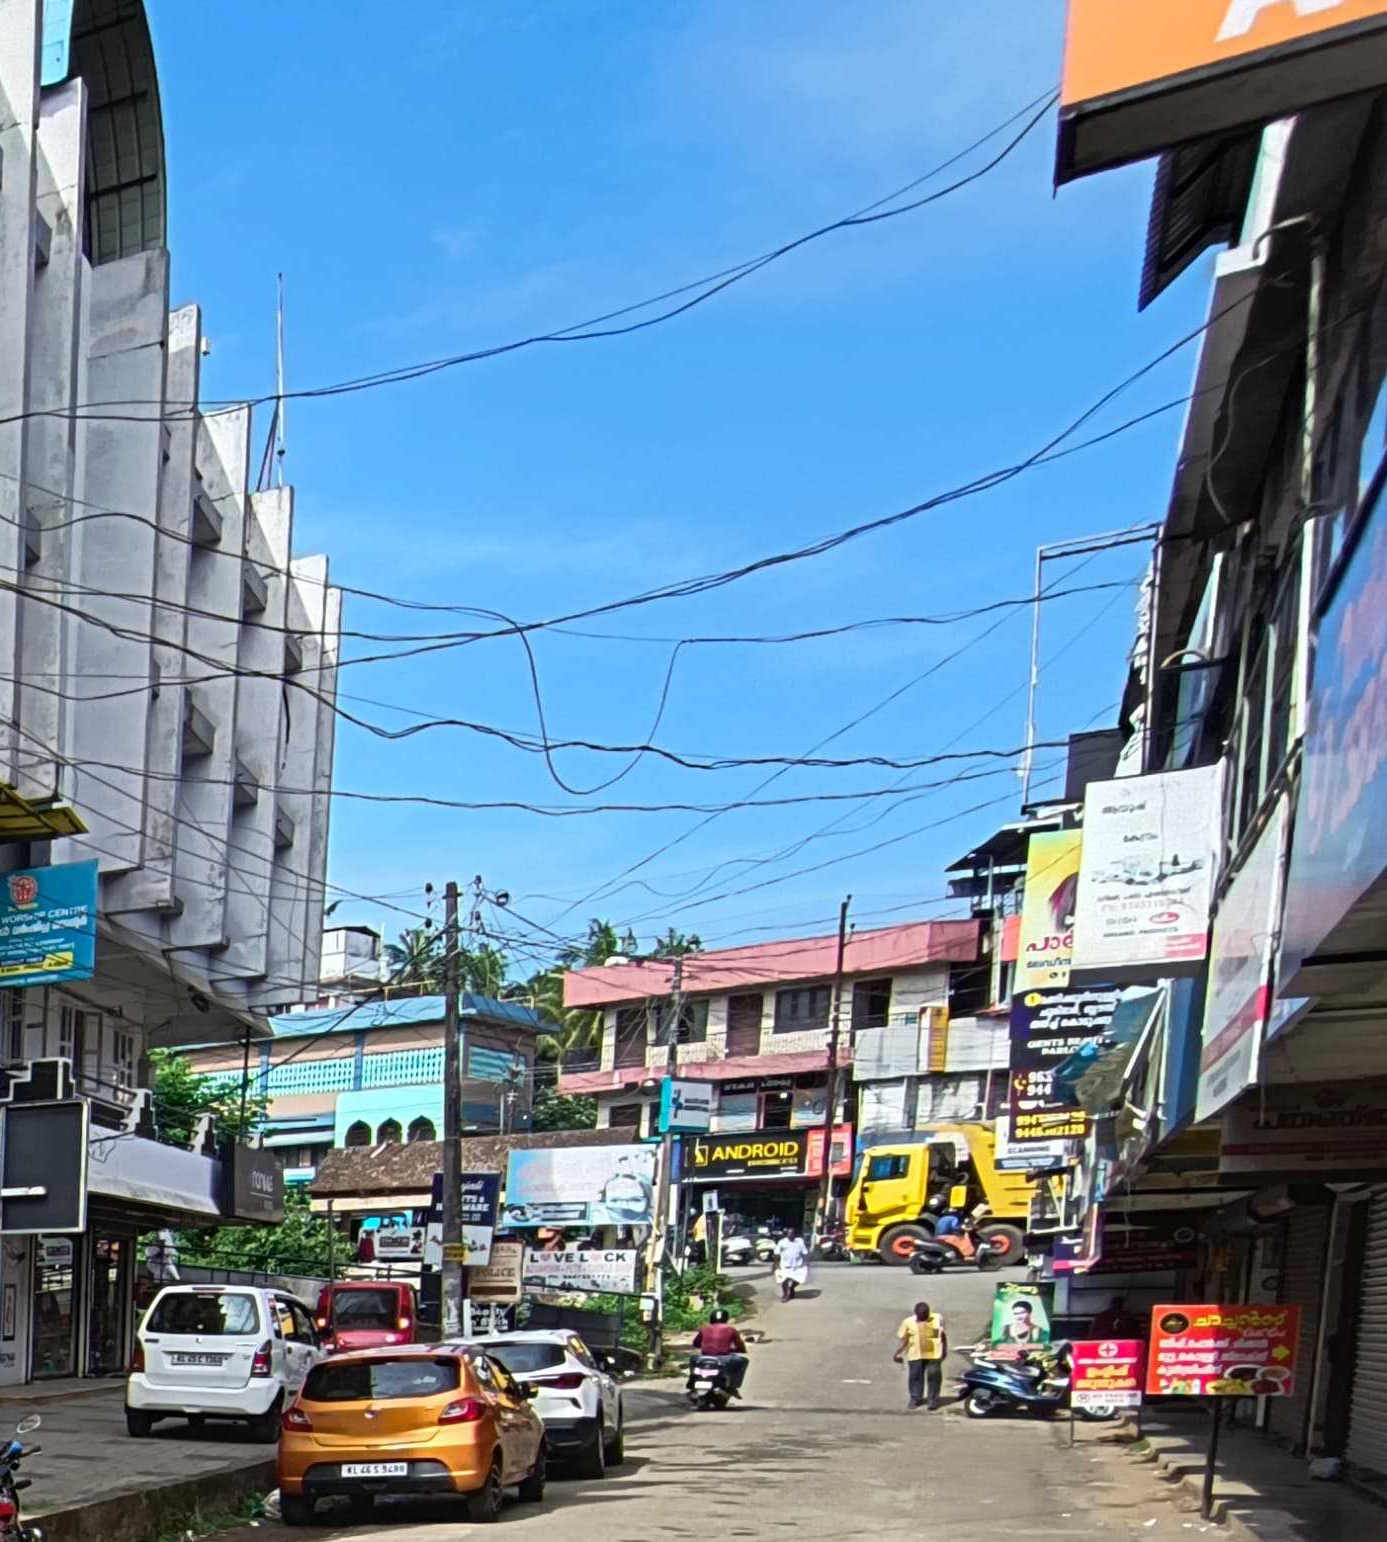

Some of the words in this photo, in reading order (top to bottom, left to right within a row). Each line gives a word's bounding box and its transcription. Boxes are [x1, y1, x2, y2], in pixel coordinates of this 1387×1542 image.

[1, 911, 46, 924] WORSHIP
[48, 905, 88, 918] CENTRE
[711, 1141, 799, 1161] ANDROID
